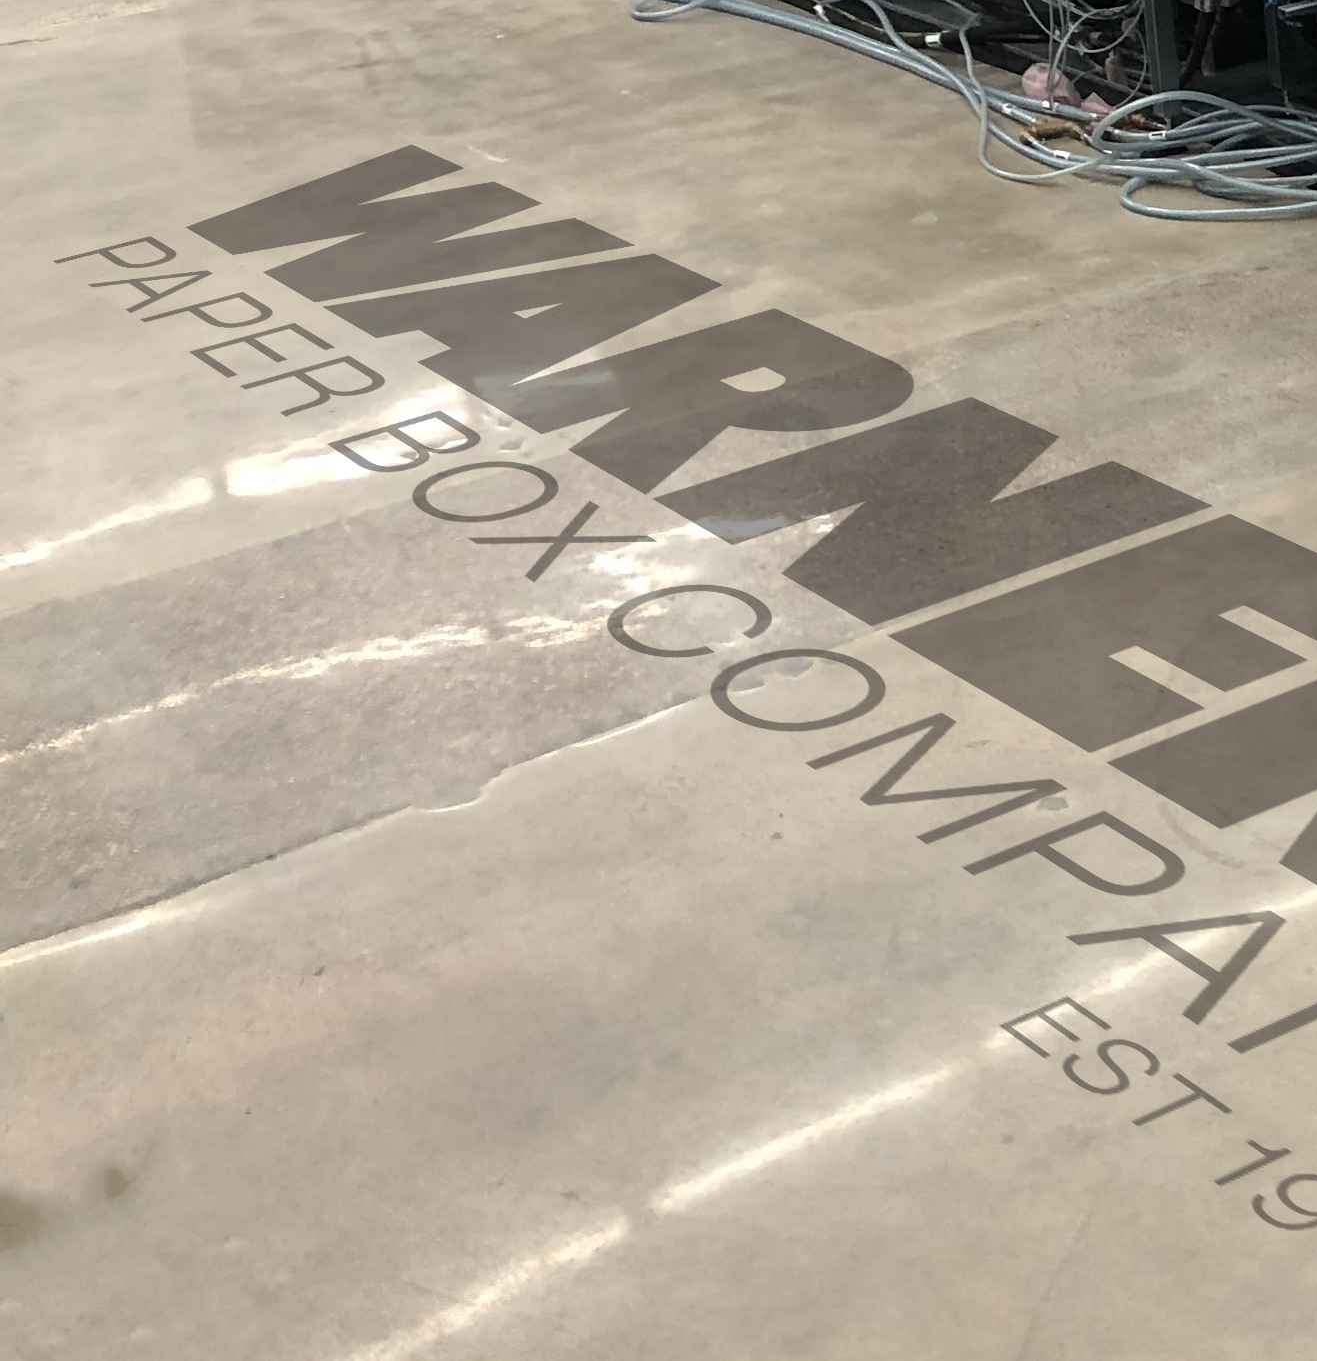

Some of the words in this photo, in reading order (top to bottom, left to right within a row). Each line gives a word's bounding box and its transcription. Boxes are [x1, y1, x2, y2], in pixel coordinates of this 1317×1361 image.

[54, 236, 385, 416] PAPER
[328, 411, 657, 581] BOX
[1000, 996, 1232, 1126] EST
